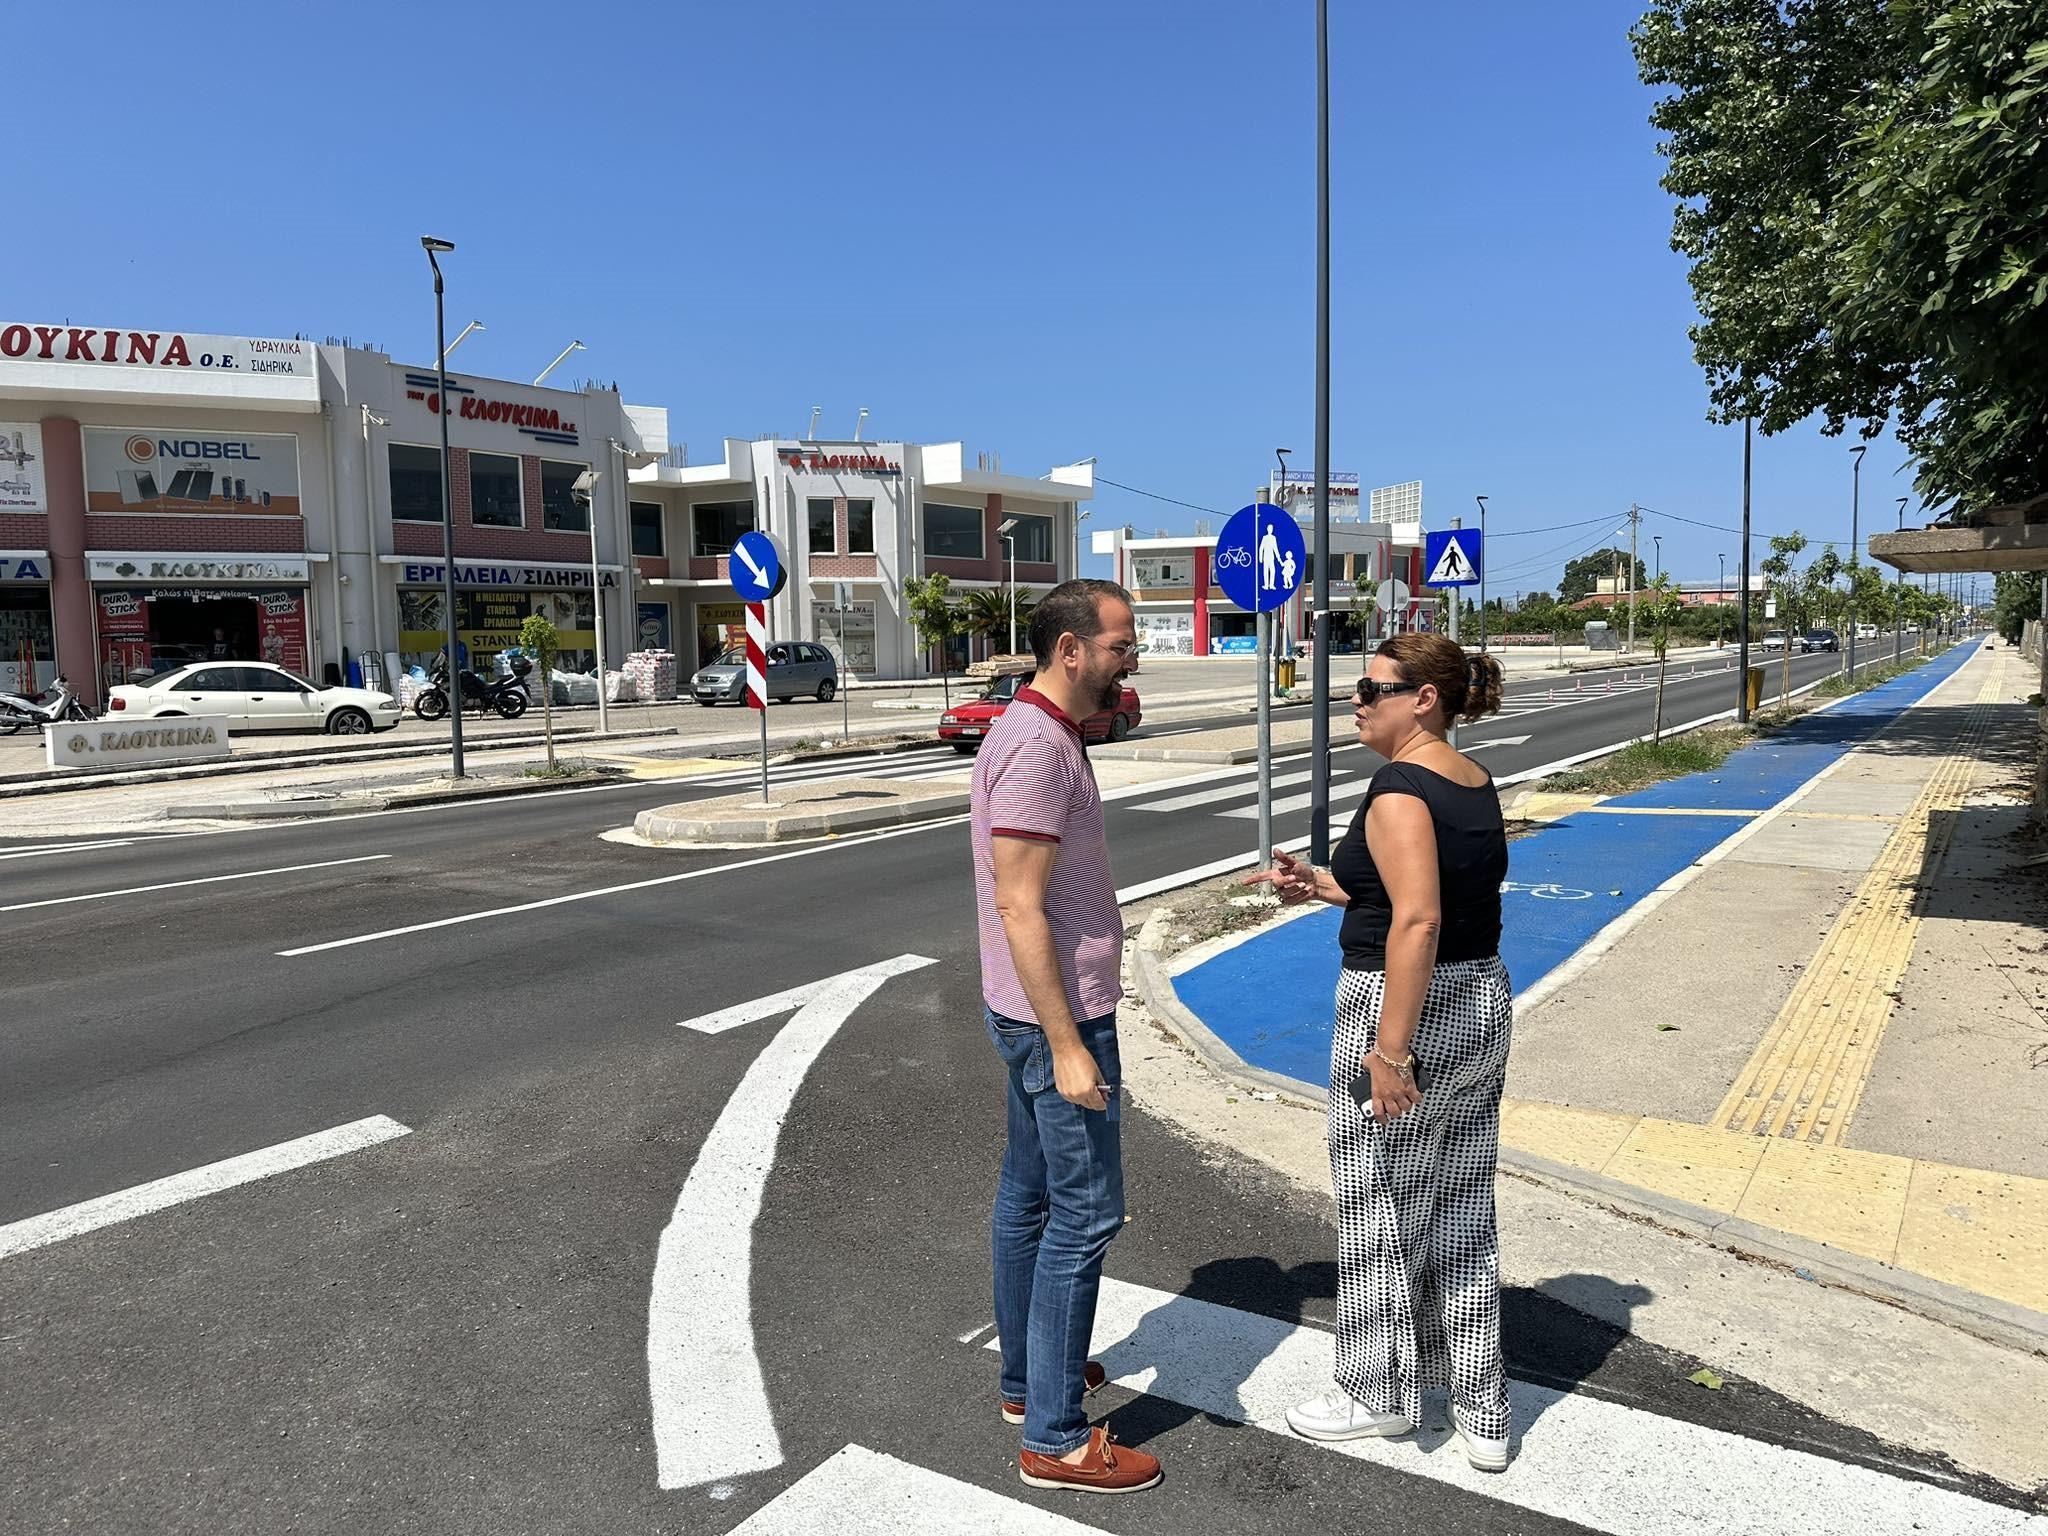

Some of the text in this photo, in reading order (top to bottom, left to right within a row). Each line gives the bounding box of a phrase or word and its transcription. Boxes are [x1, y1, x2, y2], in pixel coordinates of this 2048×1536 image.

[249, 340, 301, 355] ΥΔΡΑΥΛΙΚΑ
[200, 353, 239, 369] Ο.Ε.
[251, 359, 294, 373] ΣΙΔΗΡΙΚΑ
[460, 397, 560, 430] ΚΛΟΥΚΙΝΑ
[158, 439, 261, 460] NOBEL
[810, 455, 887, 469] ΚΛΟΥΚΙΝΑ
[150, 563, 279, 578] ΚΛΟΥΚΙΝΑ
[102, 594, 128, 605] DURO
[263, 594, 286, 604] DURO
[108, 603, 137, 615] STICK
[268, 602, 295, 614] STICK
[473, 635, 522, 646] STANLE
[68, 727, 217, 753] Φ. ΚΛΟΥΚΙΝΑ
